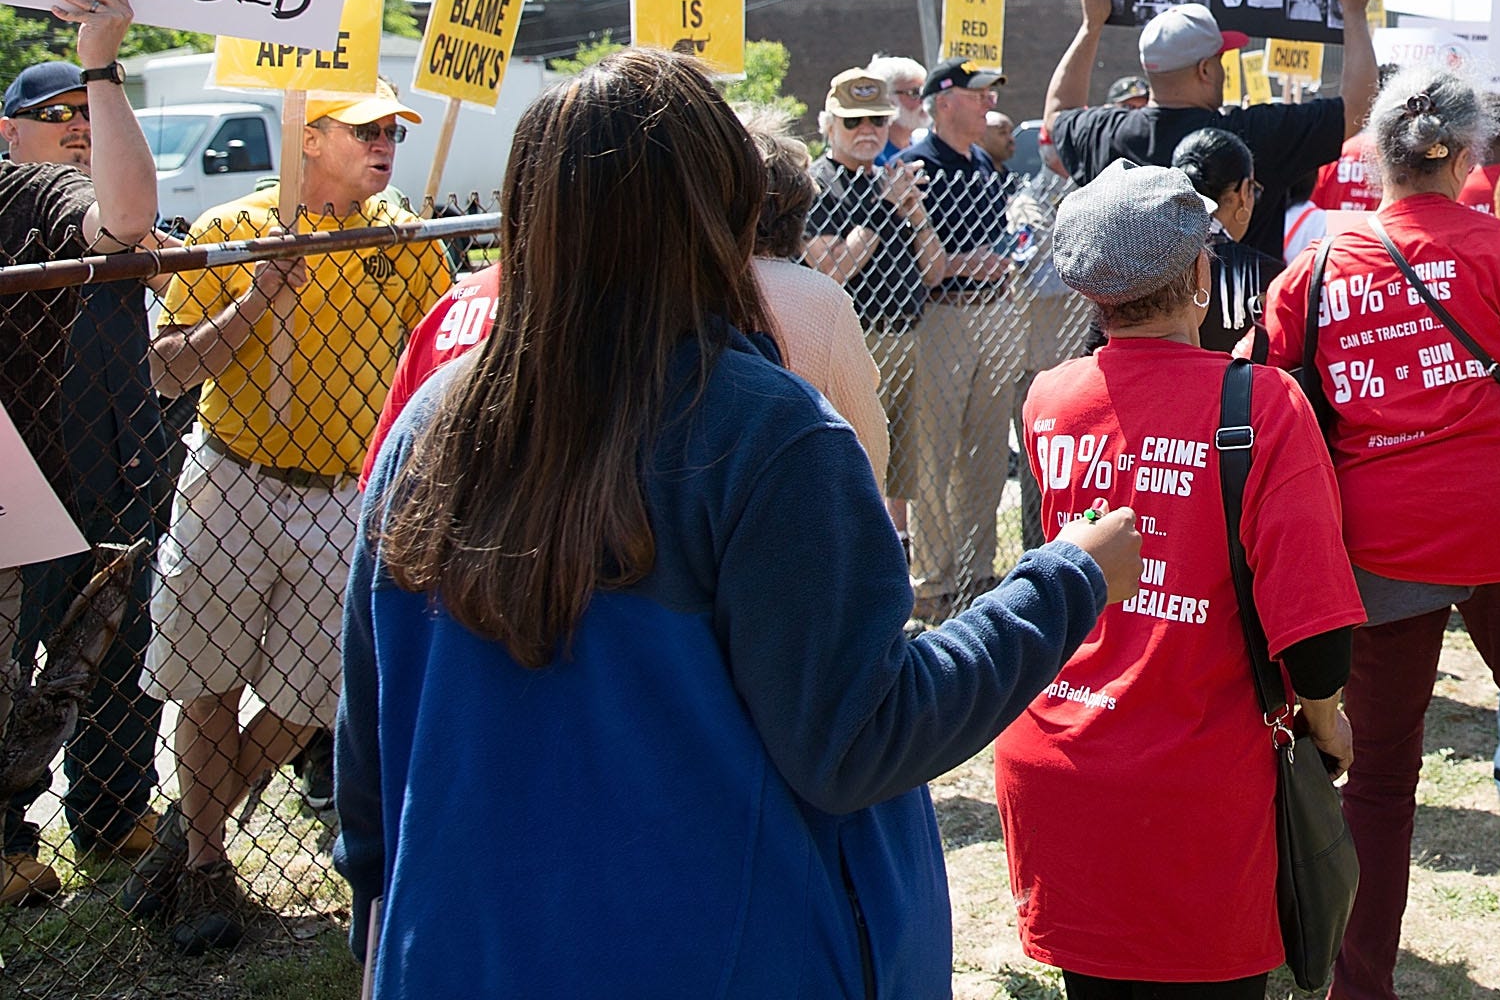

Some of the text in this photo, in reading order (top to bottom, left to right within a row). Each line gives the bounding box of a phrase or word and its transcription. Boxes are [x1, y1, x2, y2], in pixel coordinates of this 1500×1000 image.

[682, 0, 704, 29] IS
[962, 20, 988, 38] RED
[257, 31, 351, 70] APPLE
[429, 32, 507, 91] CHUCK'S
[950, 42, 998, 61] HERRING
[1274, 47, 1310, 70] CHUCK'S
[1337, 161, 1364, 184] 90
[1387, 282, 1401, 296] OF
[1407, 281, 1452, 306] GNS
[436, 297, 499, 351] 90
[1340, 333, 1360, 350] CAN
[1361, 330, 1375, 345] BE
[1375, 321, 1418, 343] TRACED
[1327, 342, 1455, 404] 5% OF GUN
[1117, 454, 1136, 471] OF
[1140, 436, 1210, 468] CRIME
[1135, 466, 1195, 497] GUNS
[1141, 516, 1167, 537] TO...
[1139, 558, 1167, 586] UN
[1122, 588, 1210, 625] DEALERS
[1042, 680, 1117, 710] pBadApples
